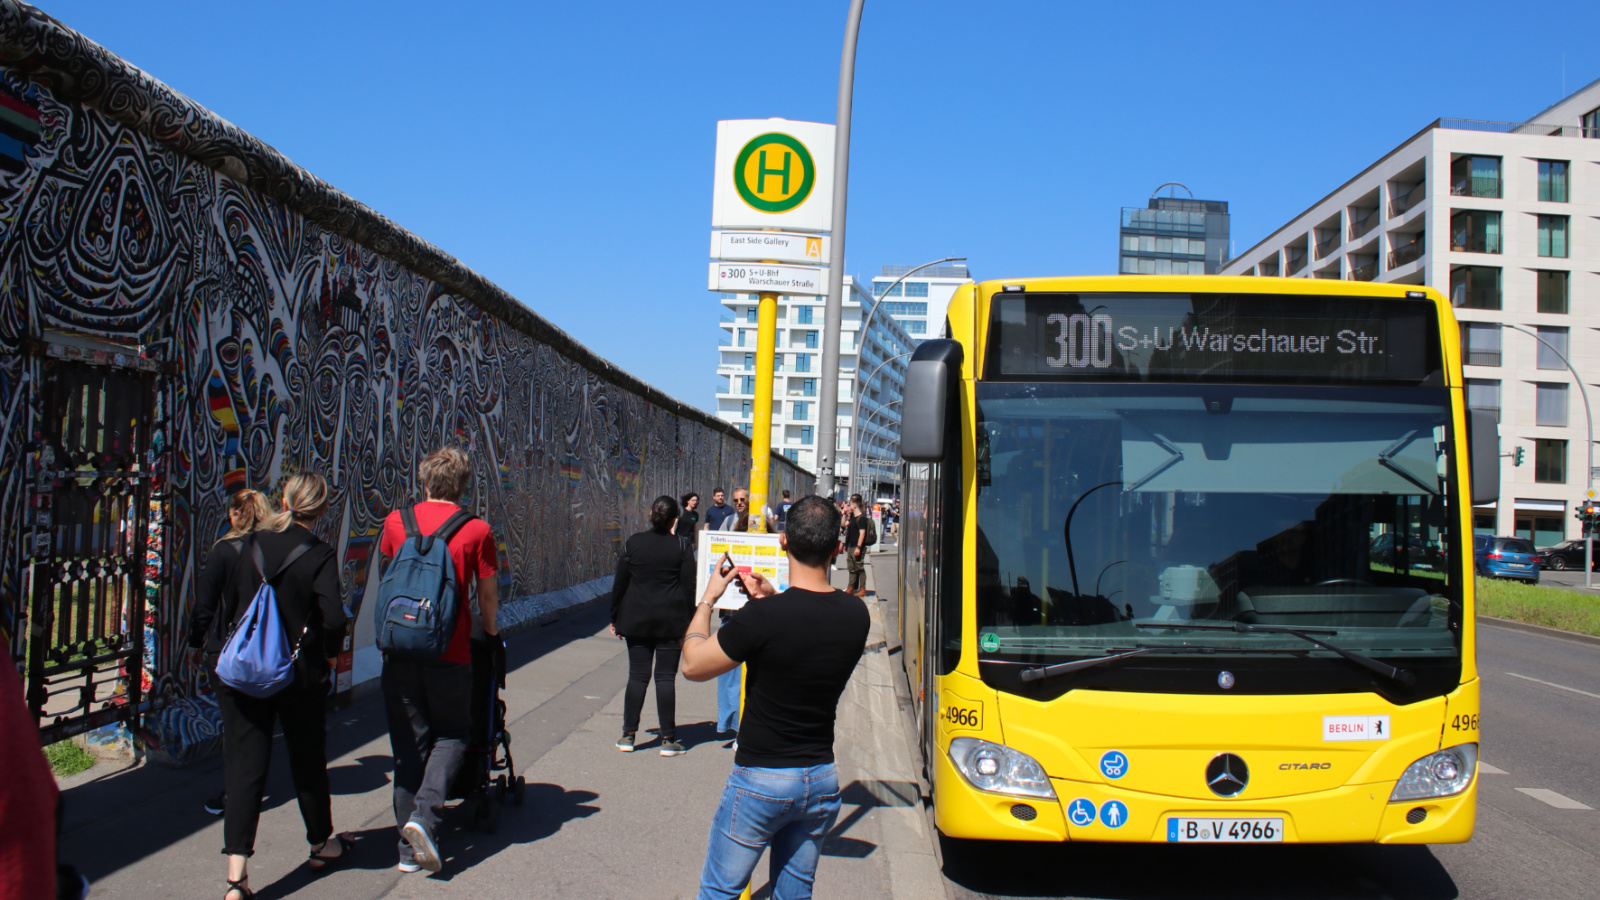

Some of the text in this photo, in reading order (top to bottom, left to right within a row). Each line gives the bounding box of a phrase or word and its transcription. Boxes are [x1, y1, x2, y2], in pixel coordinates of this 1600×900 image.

[757, 150, 791, 195] H
[730, 236, 790, 248] East Side Gallery
[807, 240, 821, 257] A
[727, 268, 746, 279] 300
[749, 269, 779, 277] S+U-Bhf
[748, 277, 815, 289] Warschauer Straße
[1046, 313, 1113, 368] 300
[1117, 326, 1384, 356] S+U Warschauer Str.
[945, 705, 978, 728] 4966
[1328, 722, 1364, 734] BERLIN
[1278, 762, 1332, 771] CITARO
[1186, 821, 1275, 840] B V 4966
